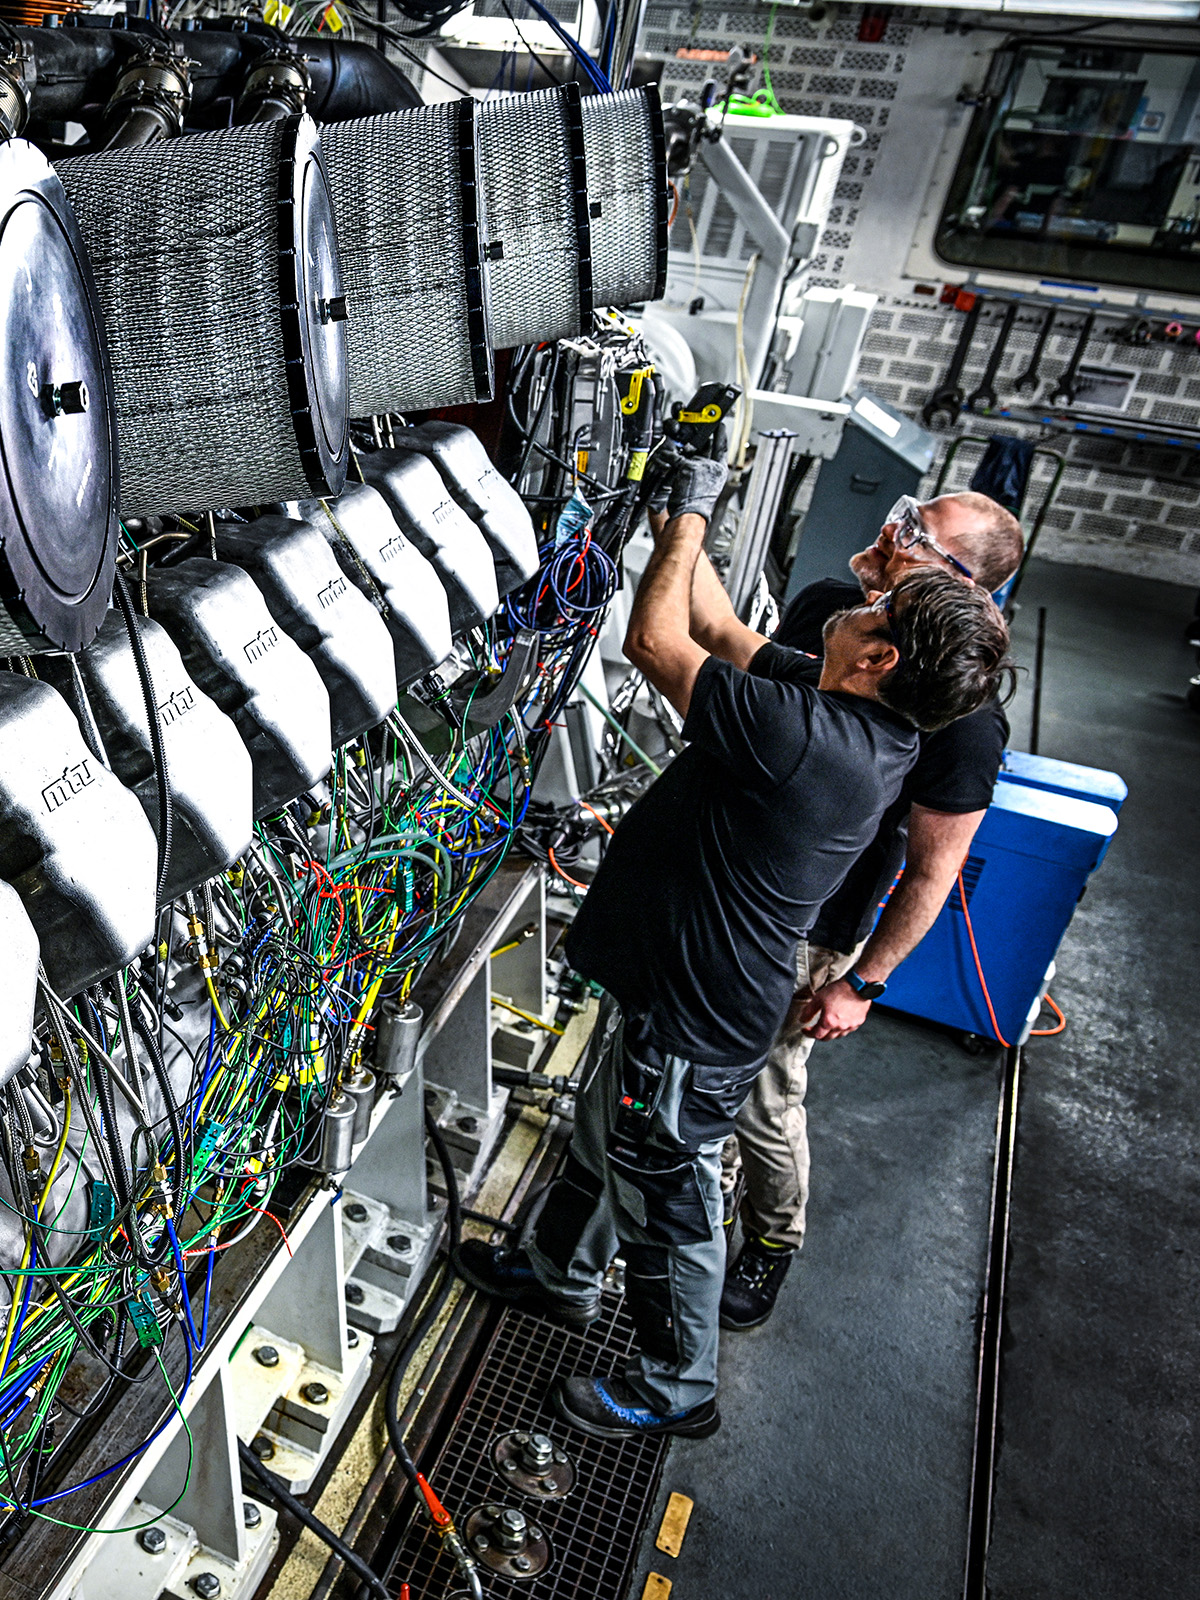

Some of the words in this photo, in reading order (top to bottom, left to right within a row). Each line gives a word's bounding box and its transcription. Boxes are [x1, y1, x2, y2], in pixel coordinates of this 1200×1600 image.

[318, 576, 347, 609] mtu
[244, 626, 279, 663] mtu
[157, 685, 197, 726] mtu
[42, 757, 96, 812] mtu
